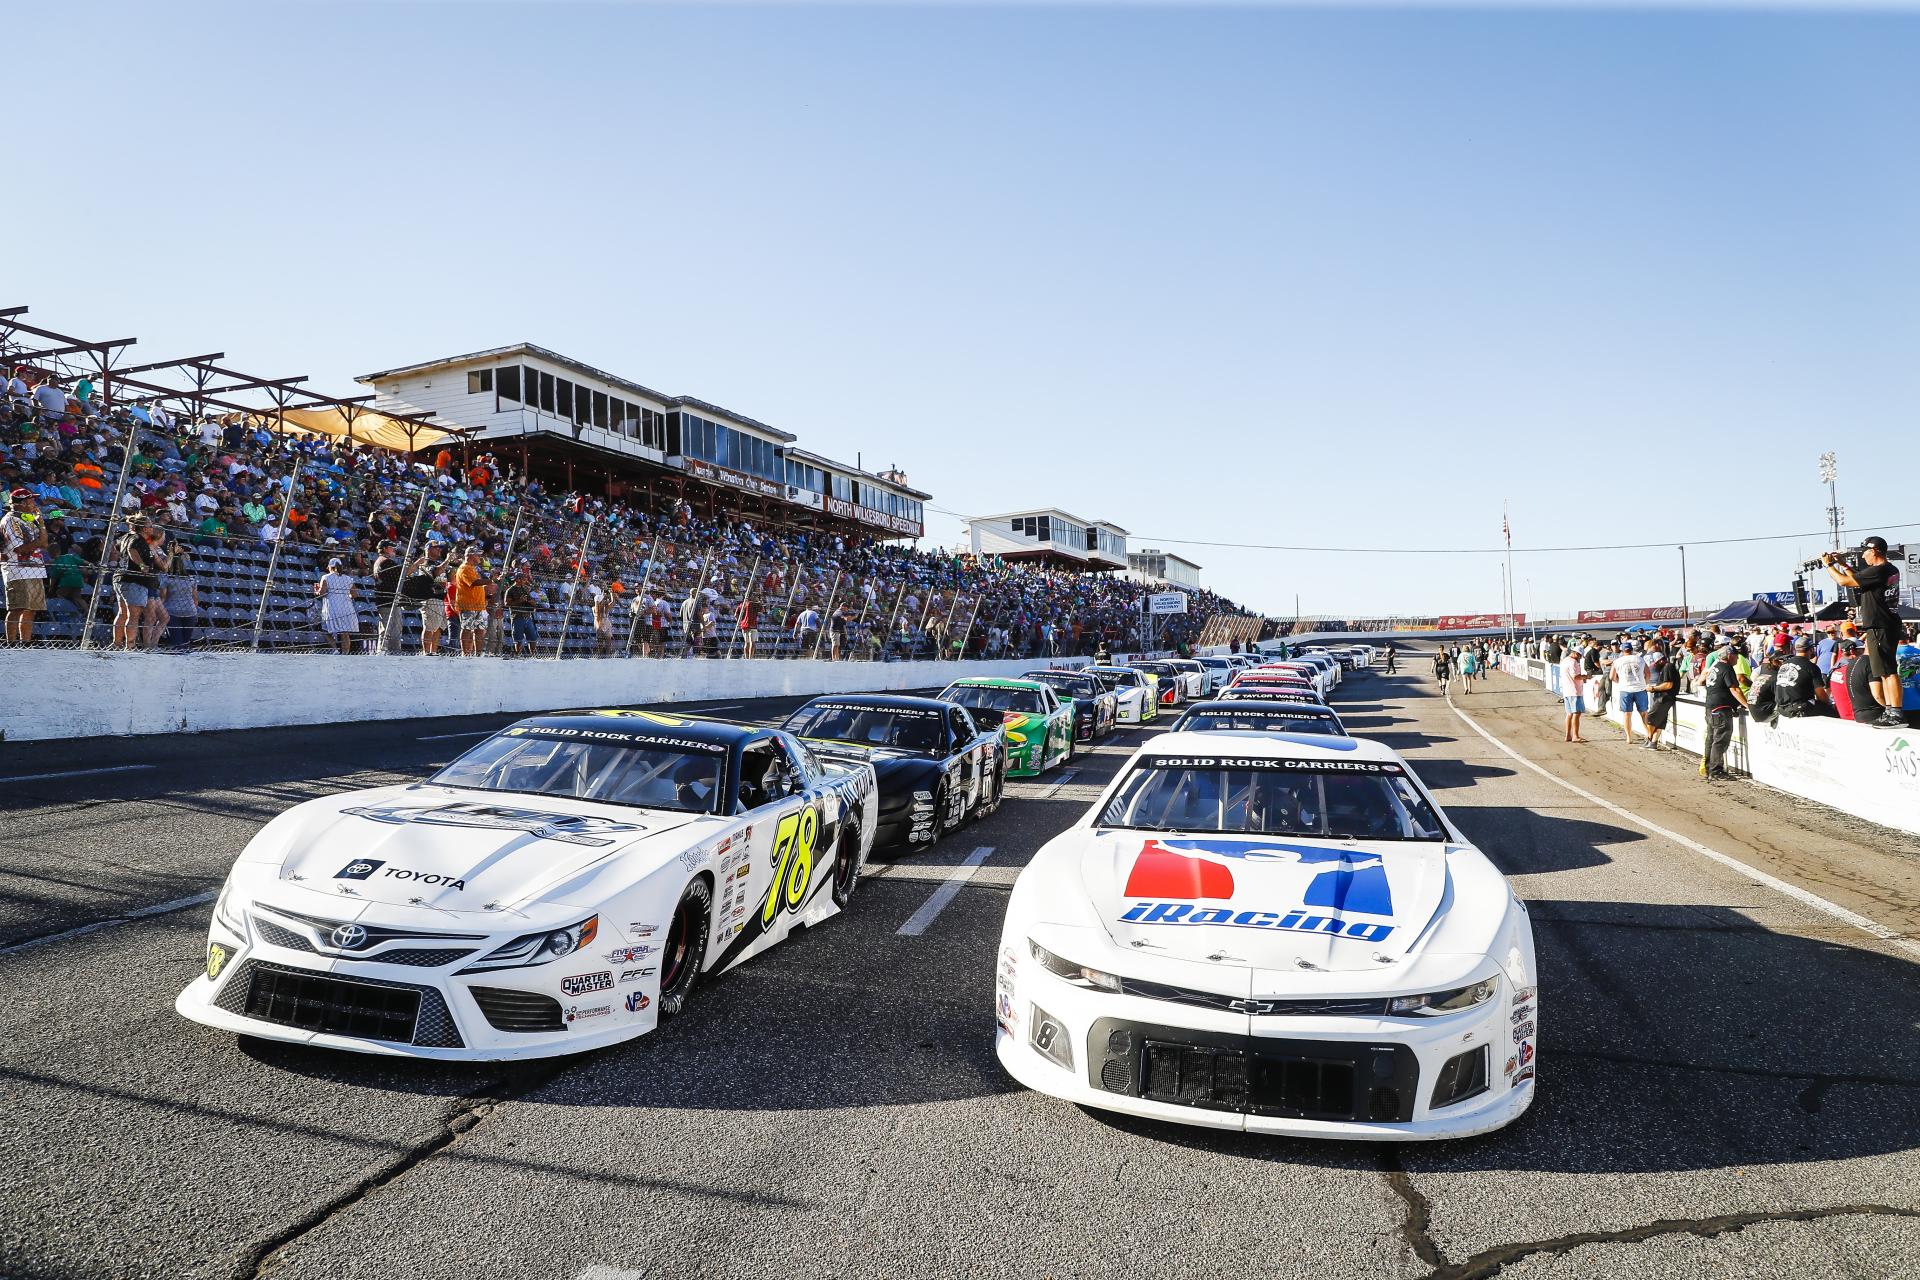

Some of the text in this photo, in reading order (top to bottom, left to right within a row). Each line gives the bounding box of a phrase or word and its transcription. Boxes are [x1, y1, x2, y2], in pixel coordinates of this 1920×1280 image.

[827, 497, 921, 535] NORTH WILKESBORO SPEEDWAY
[1651, 607, 1683, 620] Coca-Cola
[1275, 693, 1306, 701] WASTE
[844, 704, 876, 712] ROCK
[876, 706, 925, 716] CARRIERS
[1267, 712, 1318, 720] CARRIERS
[529, 727, 579, 737] SOLID
[580, 730, 631, 742] ROCK
[634, 734, 714, 750] CARRIER
[1155, 758, 1381, 772] SOLID ROCK CARRIERS
[761, 803, 819, 932] 78
[384, 867, 466, 891] TOYOTA
[1119, 902, 1395, 943] iRacing
[611, 945, 649, 958] FIVE STAR
[562, 972, 611, 990] QUARTER
[620, 967, 657, 979] PFC
[571, 980, 612, 995] MASTER
[626, 991, 643, 1012] VP
[1036, 1020, 1060, 1052] 8
